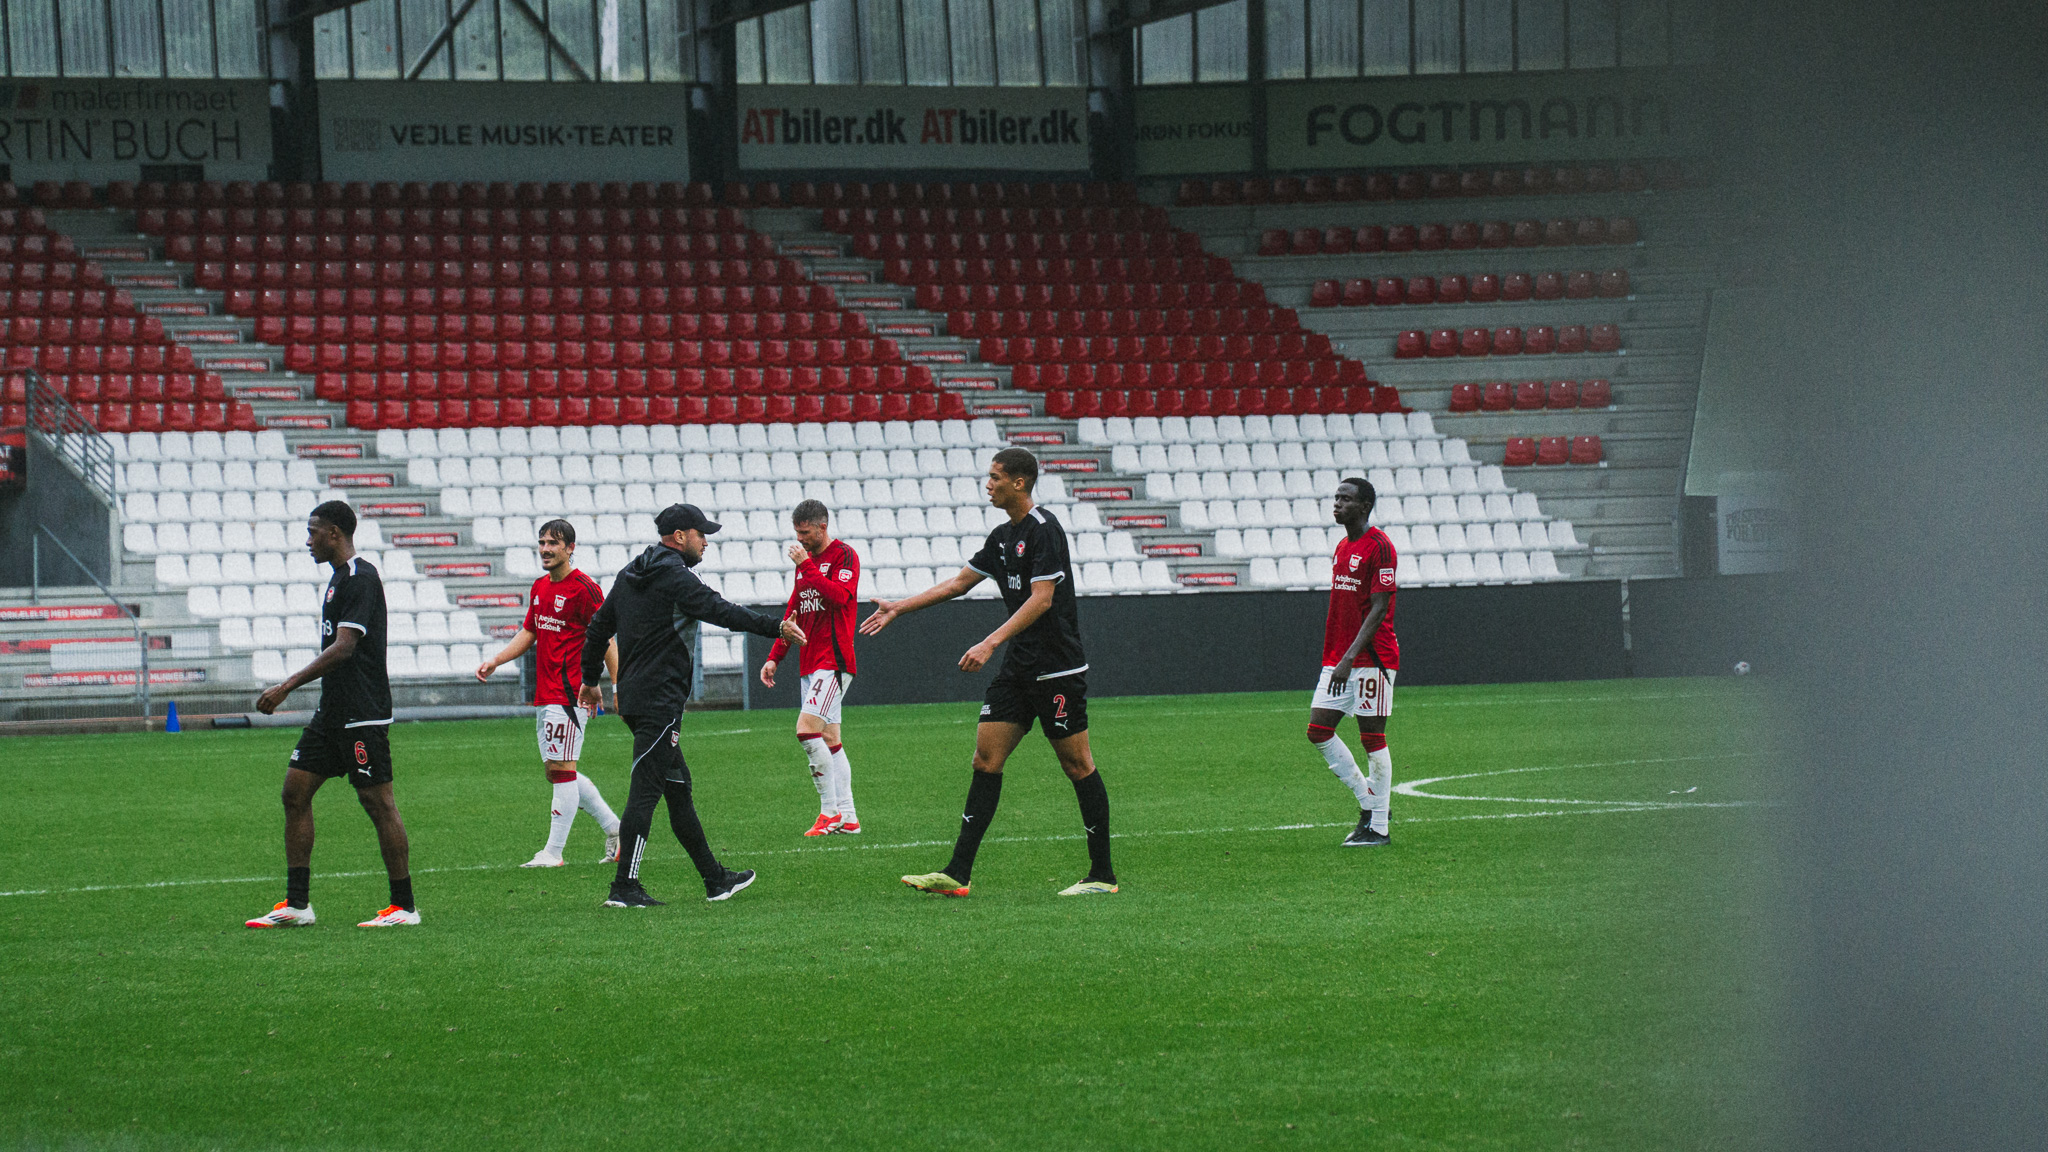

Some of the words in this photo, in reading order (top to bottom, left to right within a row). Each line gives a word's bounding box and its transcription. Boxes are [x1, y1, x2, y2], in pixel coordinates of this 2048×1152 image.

[52, 82, 237, 111] malerfirmaet
[390, 124, 472, 146] VEJLE
[741, 108, 906, 145] ATbiler.dk
[920, 108, 1080, 145] ATbiler.dk
[1135, 124, 1182, 140] RØN
[112, 118, 241, 161] BUCH
[51, 609, 68, 618] MED
[812, 679, 824, 695] 4
[1359, 678, 1377, 699] 19
[1054, 695, 1067, 718] 2
[545, 722, 566, 744] 34
[355, 741, 368, 764] 6
